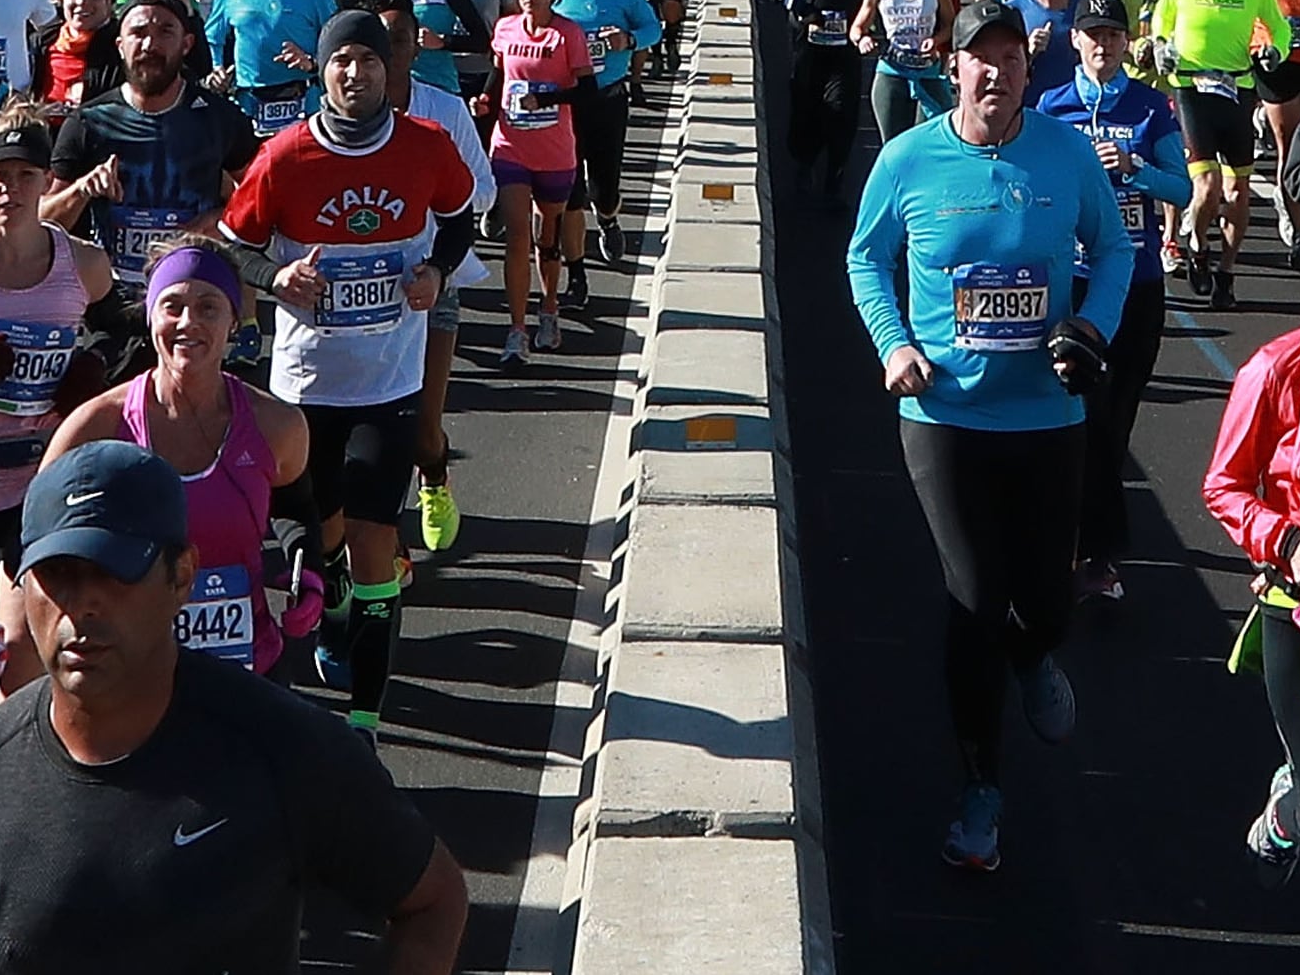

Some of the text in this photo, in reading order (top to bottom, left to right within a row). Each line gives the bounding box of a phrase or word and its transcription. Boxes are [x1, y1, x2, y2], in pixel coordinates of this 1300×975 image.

[316, 186, 405, 227] ITALIA
[340, 279, 398, 308] 38817
[979, 291, 1044, 320] 28937
[205, 586, 227, 597] TATA
